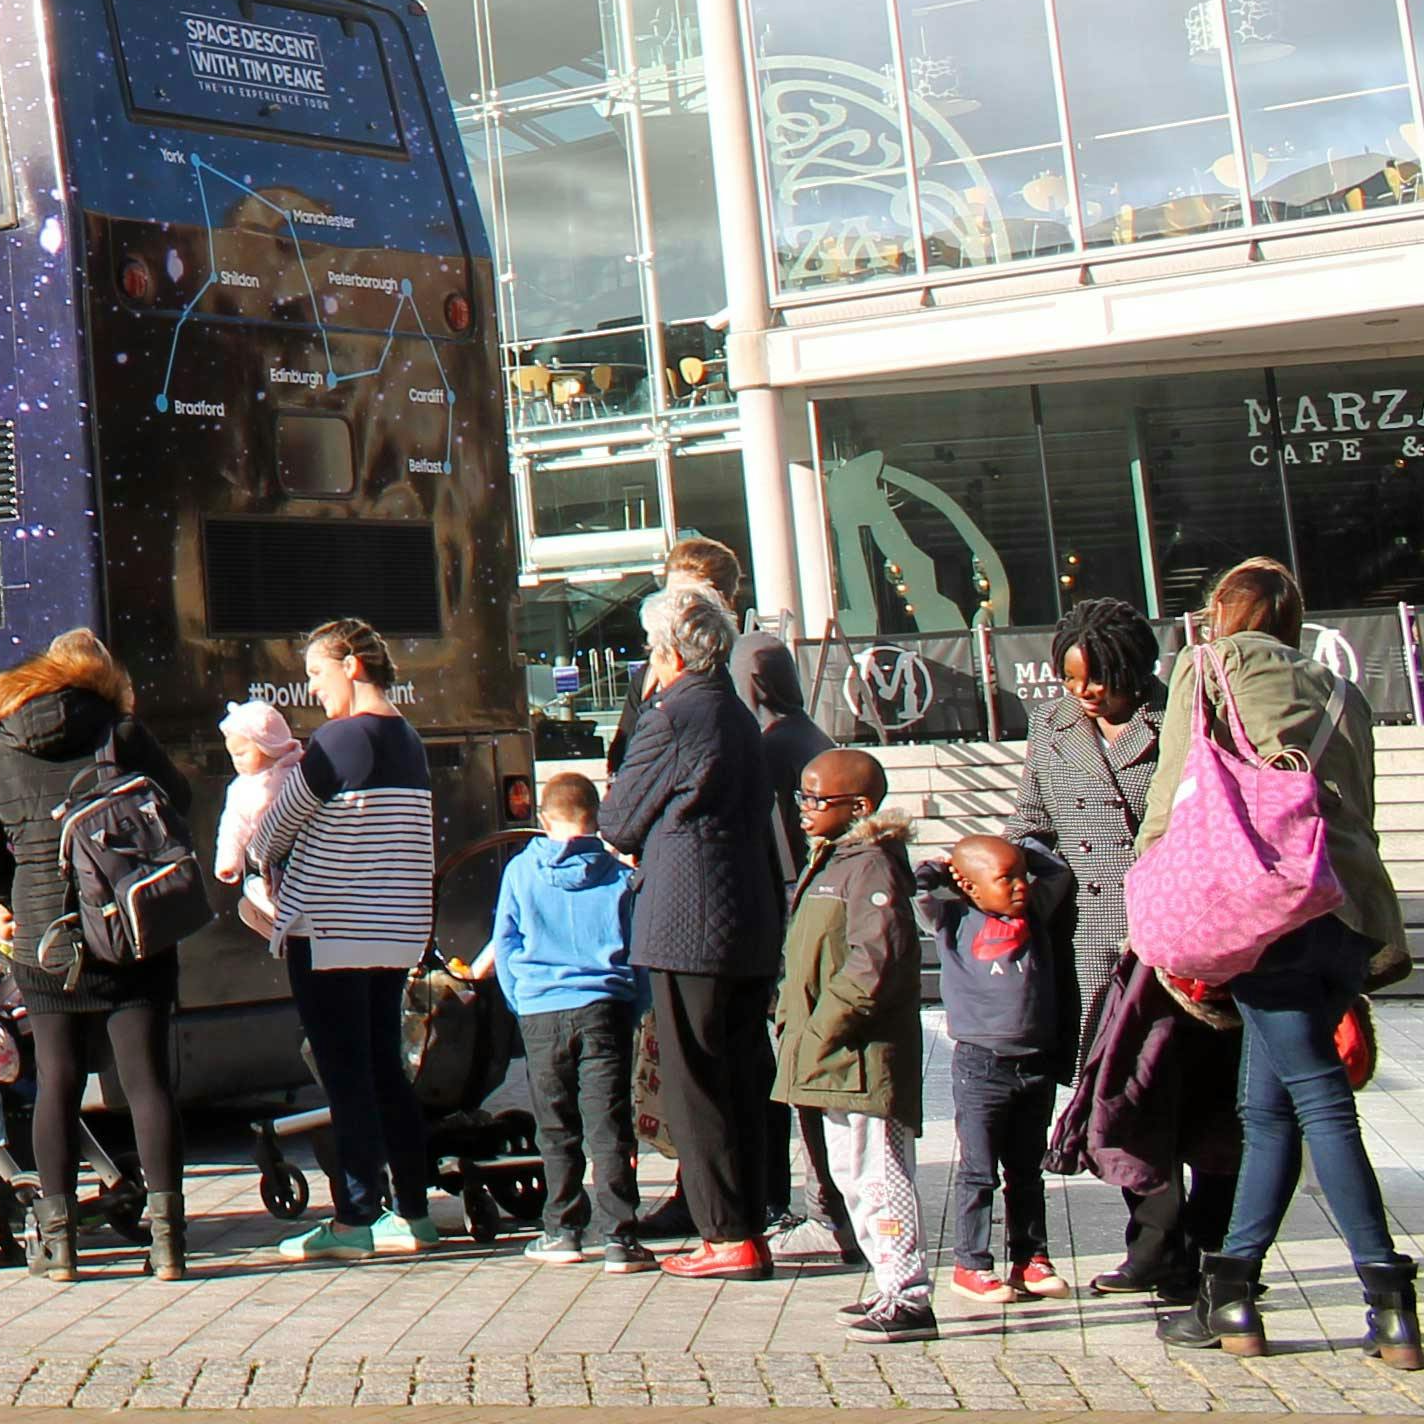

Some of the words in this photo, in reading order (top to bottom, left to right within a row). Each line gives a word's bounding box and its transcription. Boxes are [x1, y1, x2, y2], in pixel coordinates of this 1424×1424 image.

[186, 18, 240, 47] SPACE
[242, 28, 316, 60] DESCENT
[191, 50, 238, 77] WITH
[240, 58, 272, 84] TIM
[273, 64, 325, 91] PEAKE
[199, 80, 217, 93] THE
[222, 85, 235, 96] VR
[240, 87, 301, 106] EXPERIENCE
[304, 98, 330, 111] TOUR
[160, 148, 186, 165] York
[293, 209, 356, 229] Manchester
[221, 271, 259, 289] Shildon
[328, 271, 398, 294] Peterborough
[270, 367, 323, 387] Edinburgh
[409, 388, 444, 405] Cardiff
[175, 399, 225, 417] Bradford
[1244, 389, 1424, 437] MARZ
[1250, 439, 1361, 466] CAFE
[409, 458, 443, 474] Belfast
